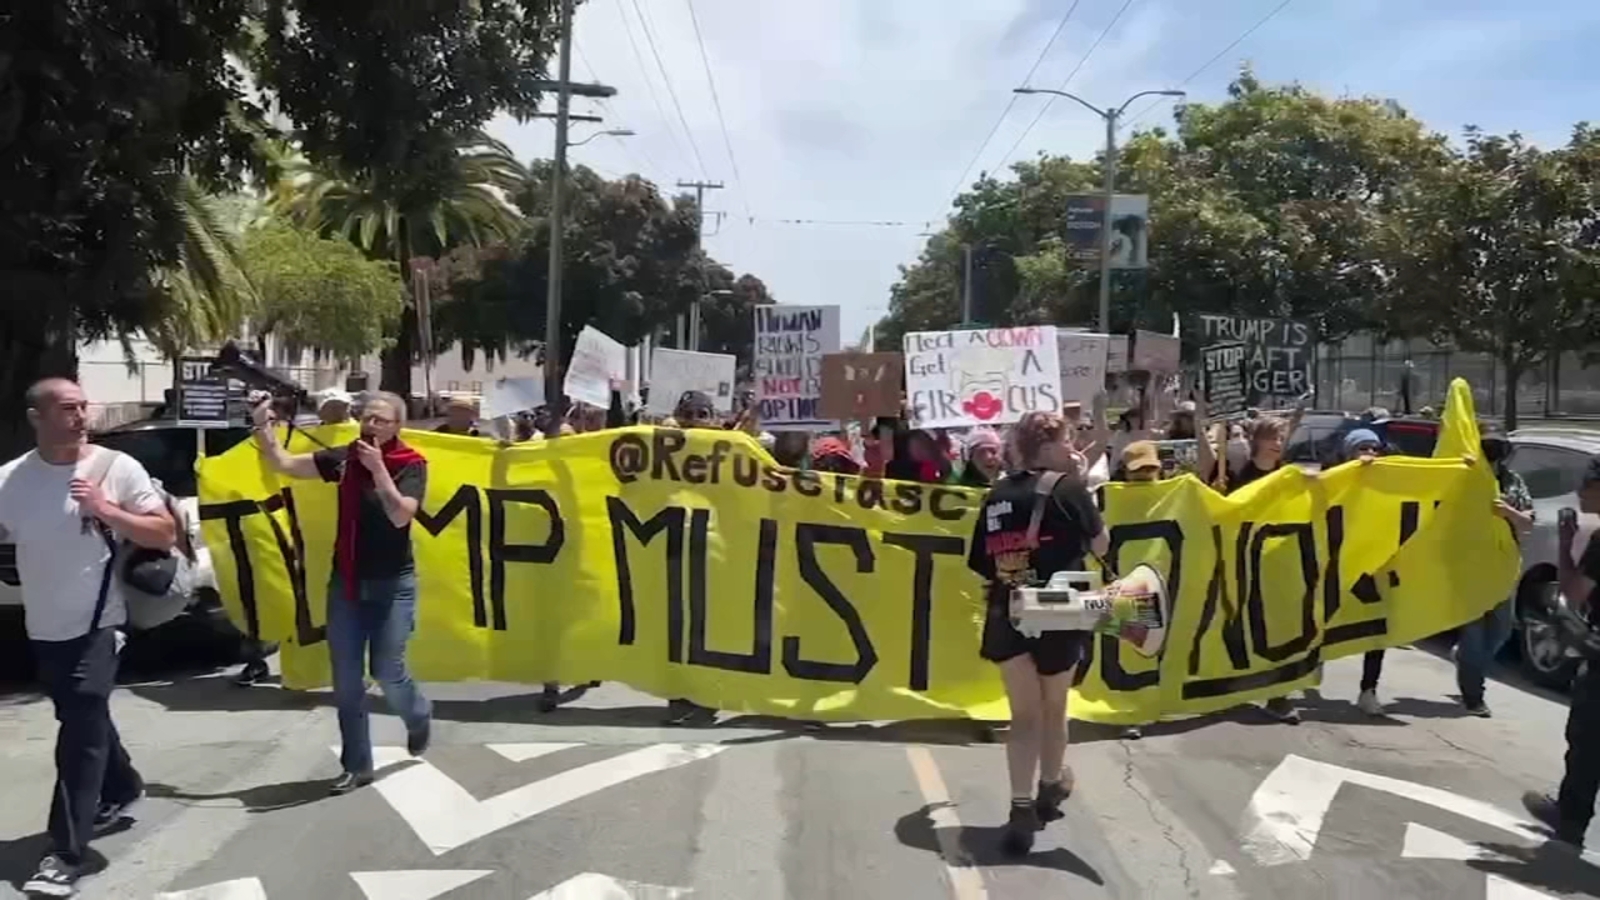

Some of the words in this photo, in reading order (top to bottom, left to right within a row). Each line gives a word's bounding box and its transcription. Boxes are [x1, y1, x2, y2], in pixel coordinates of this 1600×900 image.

[1199, 315, 1275, 342] TRUMP
[1283, 323, 1307, 345] IS
[183, 362, 214, 380] ST
[909, 353, 946, 376] Get
[1022, 349, 1043, 376] A
[1205, 347, 1244, 371] STOP
[763, 378, 802, 397] NOT
[606, 495, 966, 692] MUST
